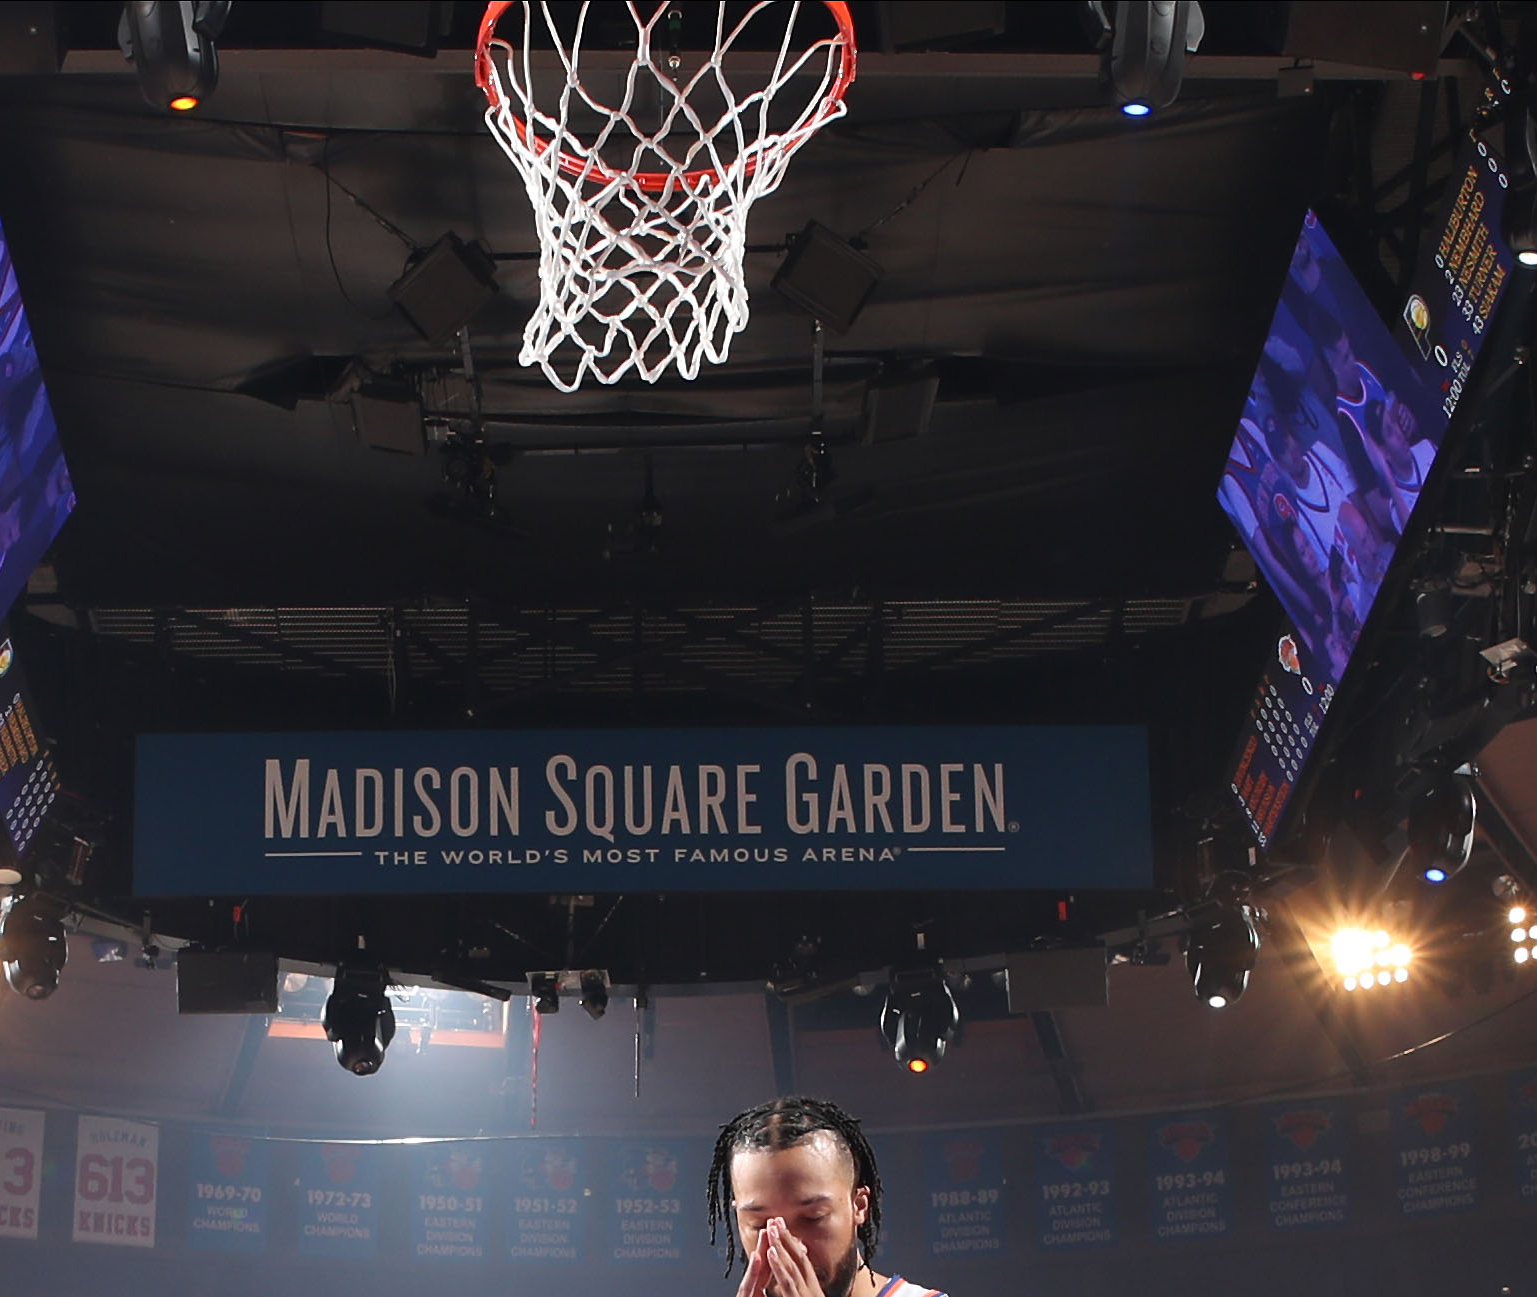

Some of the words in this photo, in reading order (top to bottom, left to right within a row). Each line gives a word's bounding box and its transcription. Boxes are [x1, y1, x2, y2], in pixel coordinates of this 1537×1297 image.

[1434, 345, 1448, 367] 0
[1301, 676, 1313, 695] 0
[264, 758, 519, 839] MADISON
[545, 754, 762, 843] SQUARE
[374, 850, 428, 866] THE
[441, 849, 569, 865] WORLD'S
[583, 848, 660, 864] MOST
[674, 847, 789, 863] FAMOUS
[1400, 1142, 1471, 1167] 1998-99
[78, 1153, 155, 1206] 613
[1272, 1160, 1343, 1180] 1993-94
[1042, 1180, 1111, 1200] 1992-93
[1155, 1169, 1226, 1192] 1993-94
[196, 1183, 262, 1203] 1969-70
[306, 1189, 372, 1208] 1972-73
[930, 1188, 1000, 1208] 1988-89
[418, 1194, 483, 1213] 1950-51
[515, 1198, 578, 1214] 1951-52
[615, 1198, 680, 1214] 1952-53
[77, 1210, 151, 1237] KNICKS
